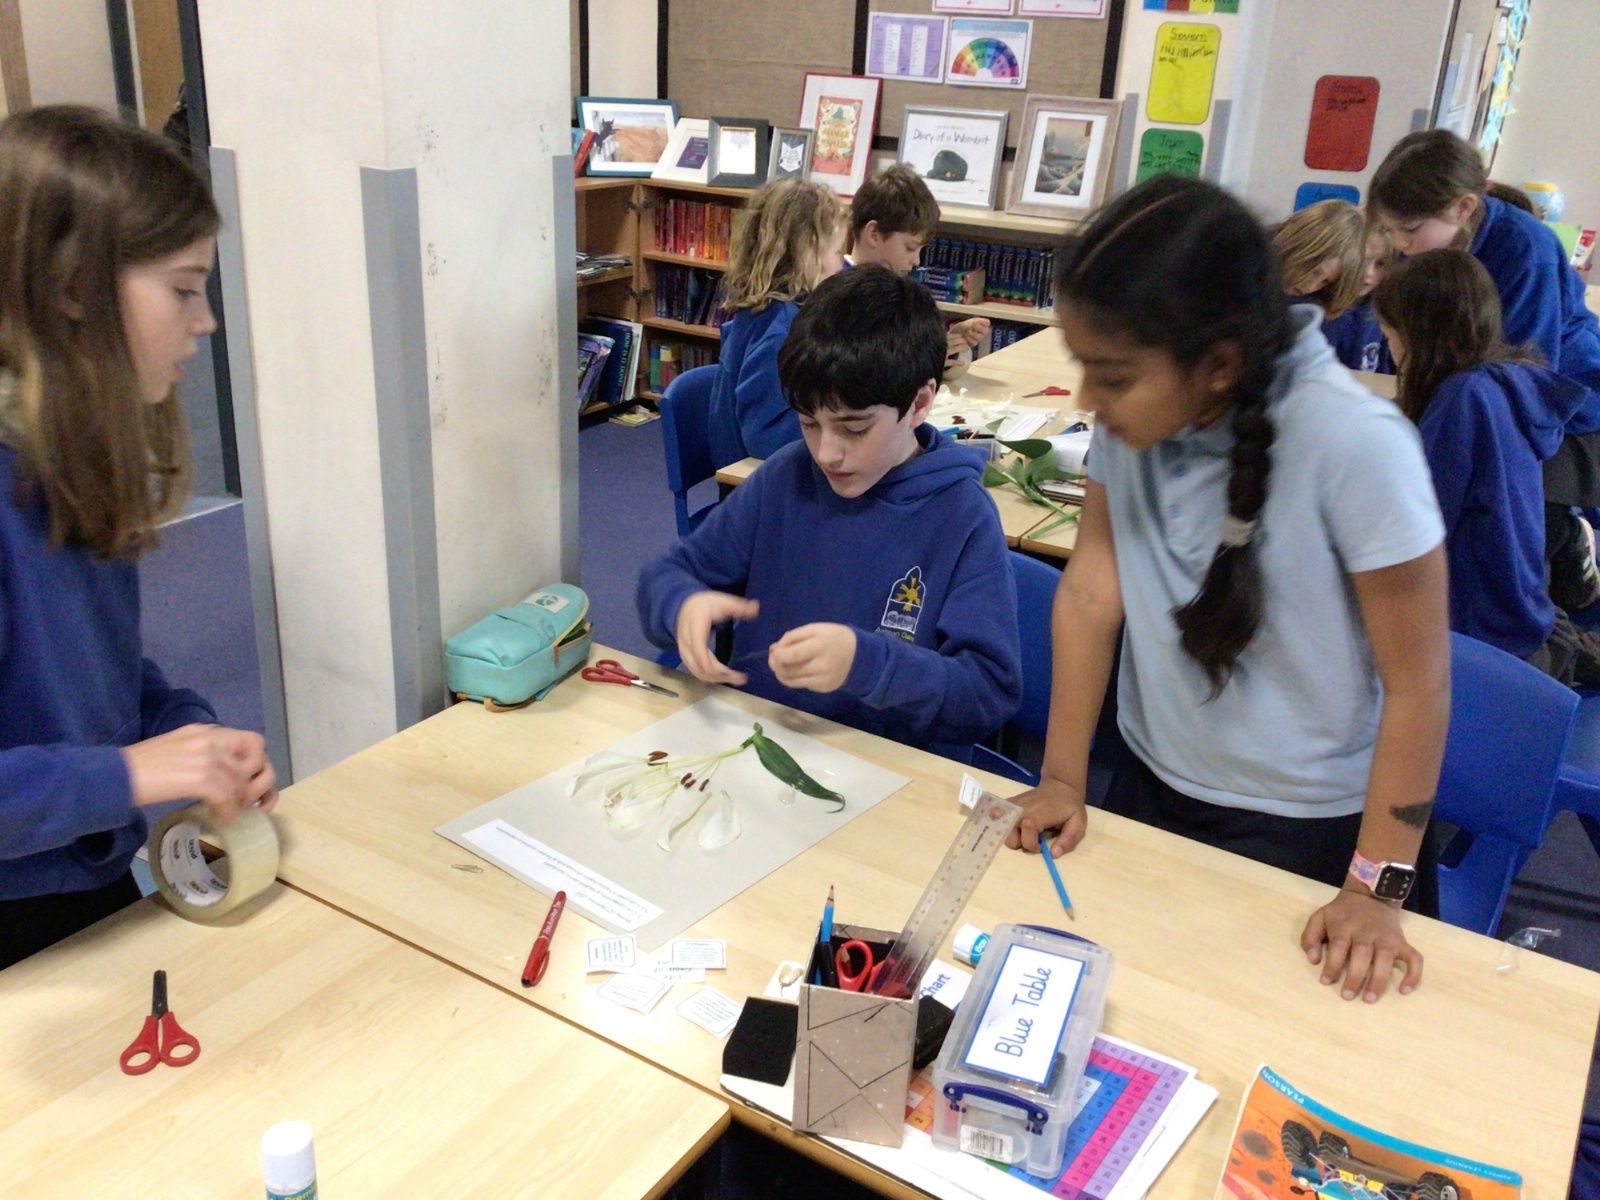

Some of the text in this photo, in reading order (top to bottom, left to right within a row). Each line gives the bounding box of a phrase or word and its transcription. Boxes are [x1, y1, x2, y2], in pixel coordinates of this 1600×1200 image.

[913, 128, 934, 144] Diary
[936, 131, 945, 142] of
[954, 131, 991, 145] Wombat
[920, 973, 951, 1000] Chart
[994, 967, 1052, 1058] Blue Table
[1262, 1069, 1305, 1105] PEARSON
